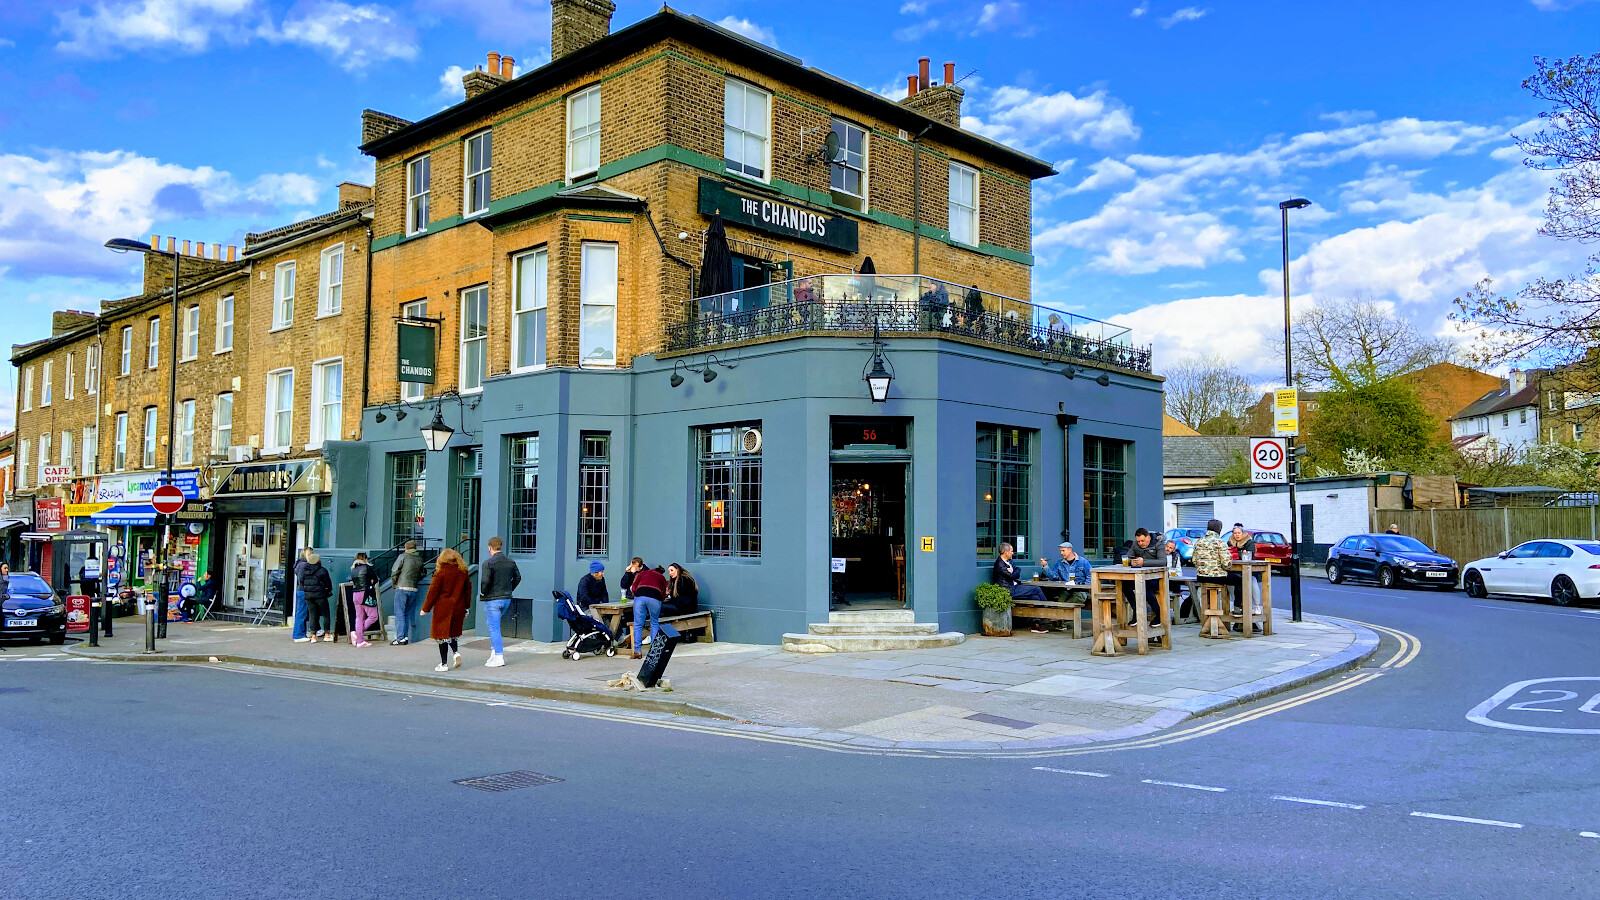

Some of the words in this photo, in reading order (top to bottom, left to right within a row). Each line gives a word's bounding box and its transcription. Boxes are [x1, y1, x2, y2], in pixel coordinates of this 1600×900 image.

[741, 198, 758, 216] THE
[762, 200, 826, 237] CHANDOS
[401, 365, 432, 377] CHANDOS
[863, 429, 877, 441] 56
[1258, 449, 1279, 461] 20
[44, 467, 70, 475] CAFE
[1255, 472, 1283, 480] ZONE
[923, 538, 933, 550] H
